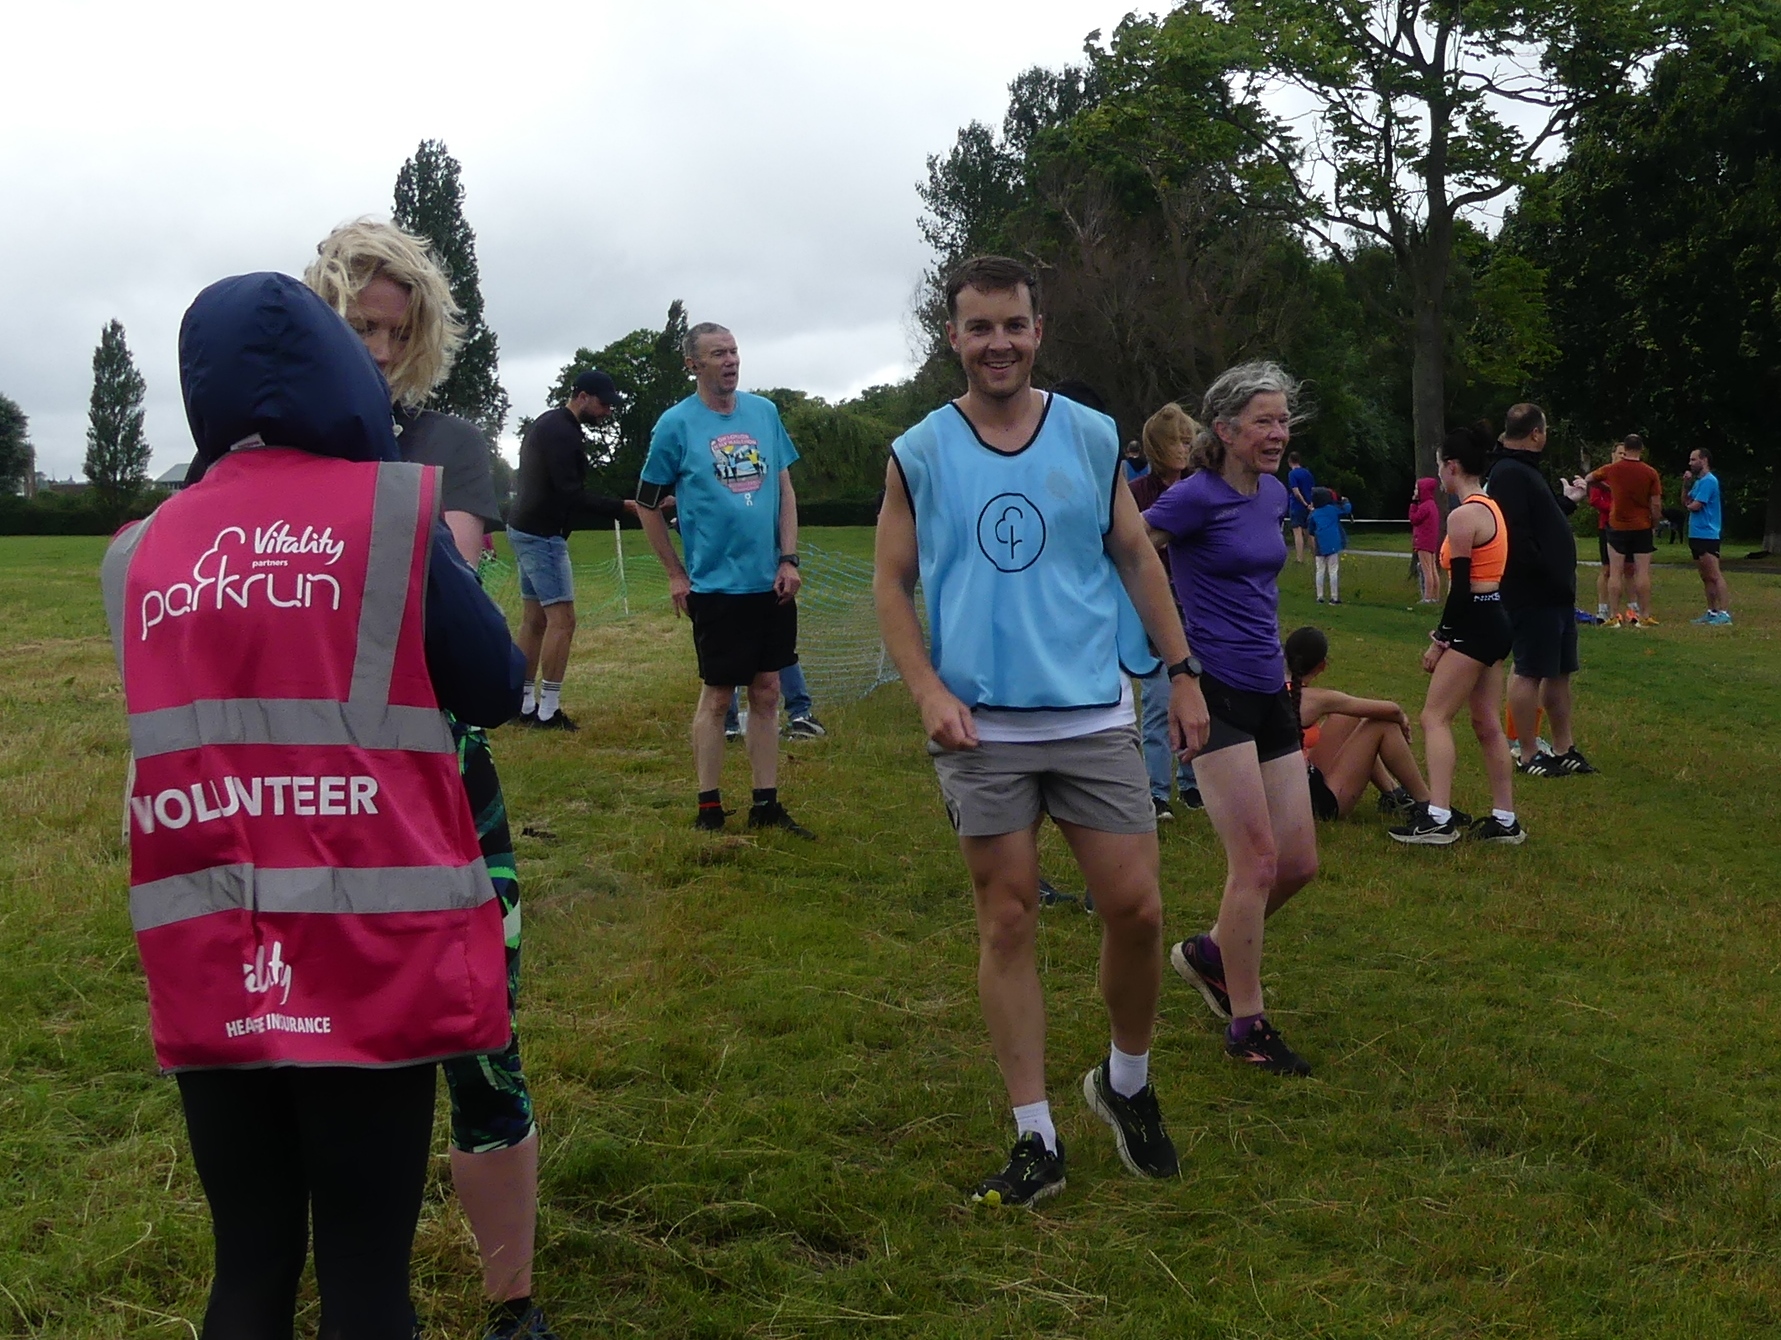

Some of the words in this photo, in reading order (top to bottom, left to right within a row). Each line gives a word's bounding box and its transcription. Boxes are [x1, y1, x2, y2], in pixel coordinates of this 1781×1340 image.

[252, 559, 288, 568] partners
[254, 520, 345, 565] Vitality
[142, 527, 340, 641] parkrun
[131, 776, 378, 834] VOLUNTEER
